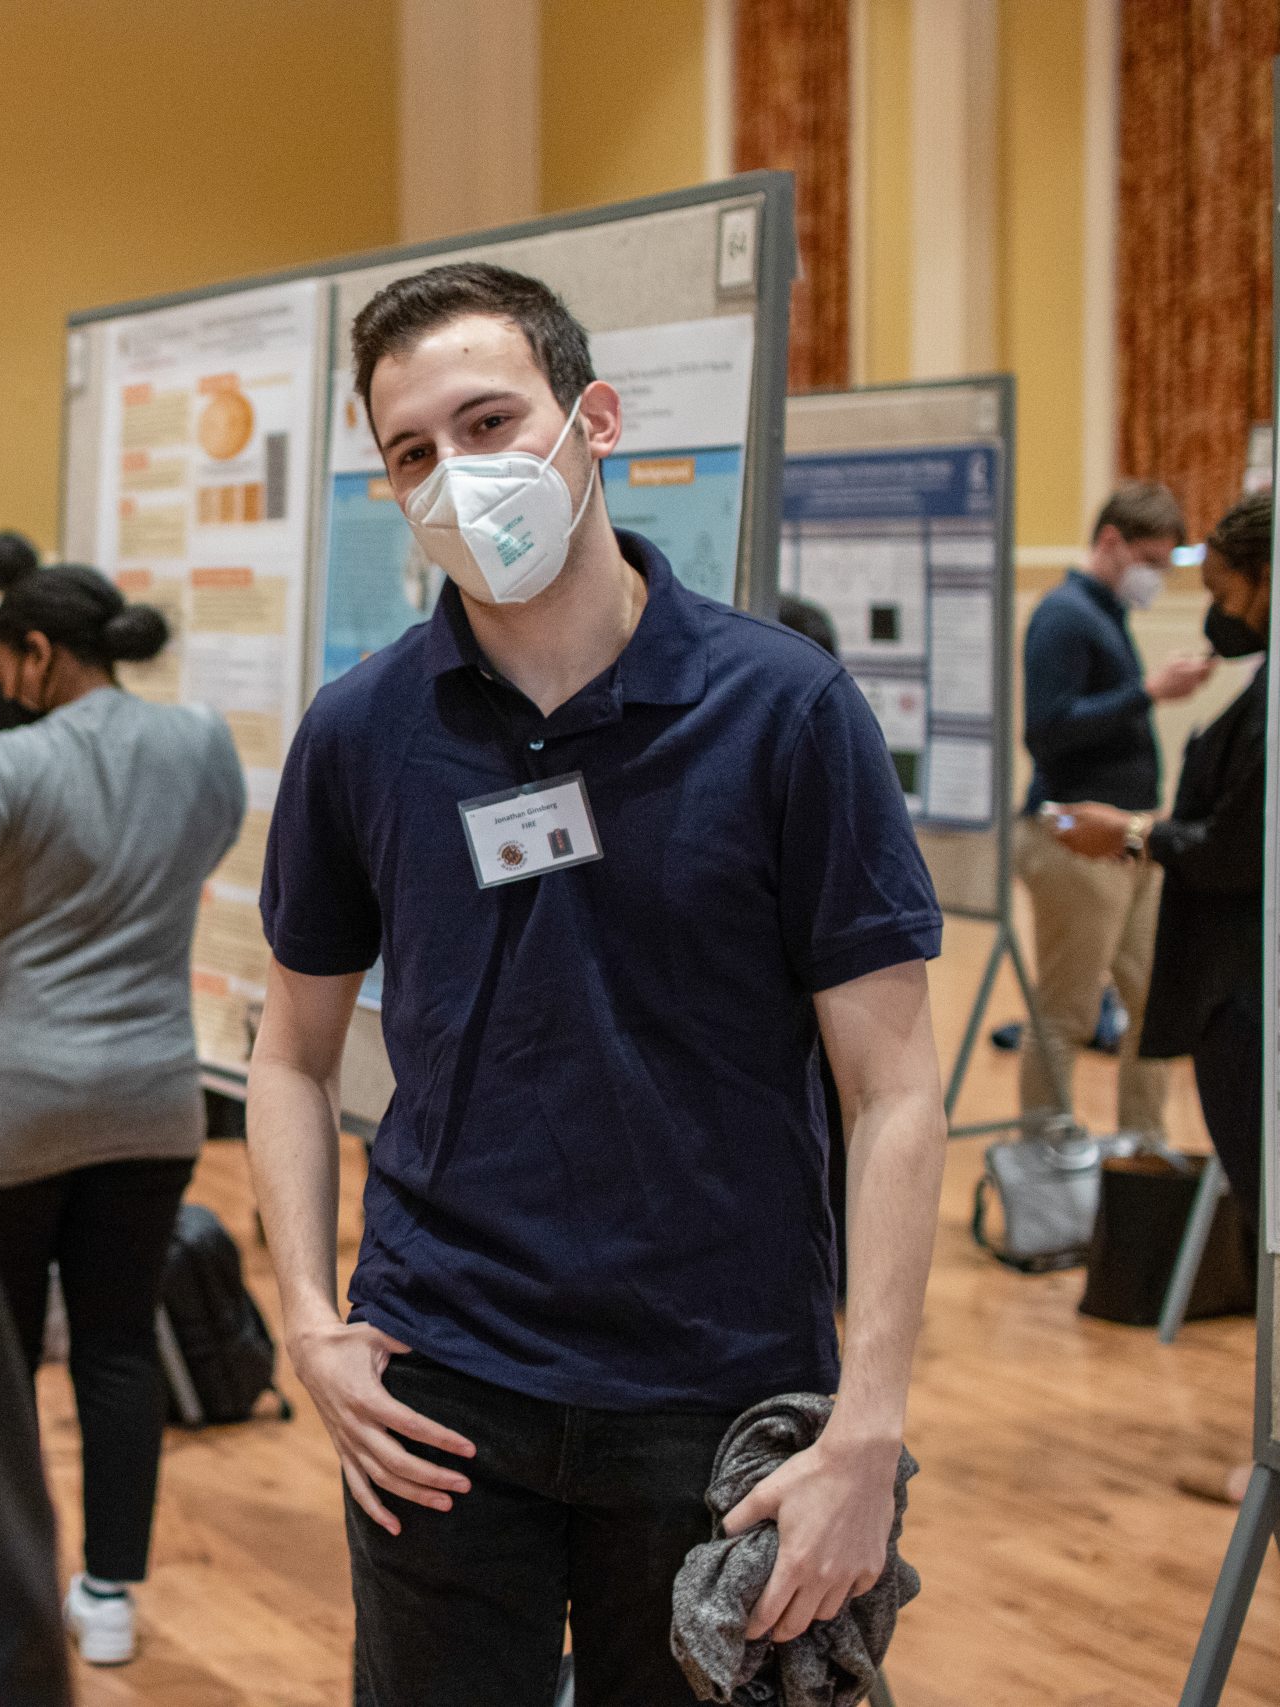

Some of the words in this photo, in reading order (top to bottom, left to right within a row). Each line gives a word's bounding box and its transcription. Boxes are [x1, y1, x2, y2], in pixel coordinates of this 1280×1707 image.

[494, 811, 526, 824] Jonathan
[527, 802, 558, 815] Ginsberg
[521, 820, 536, 830] FIRE
